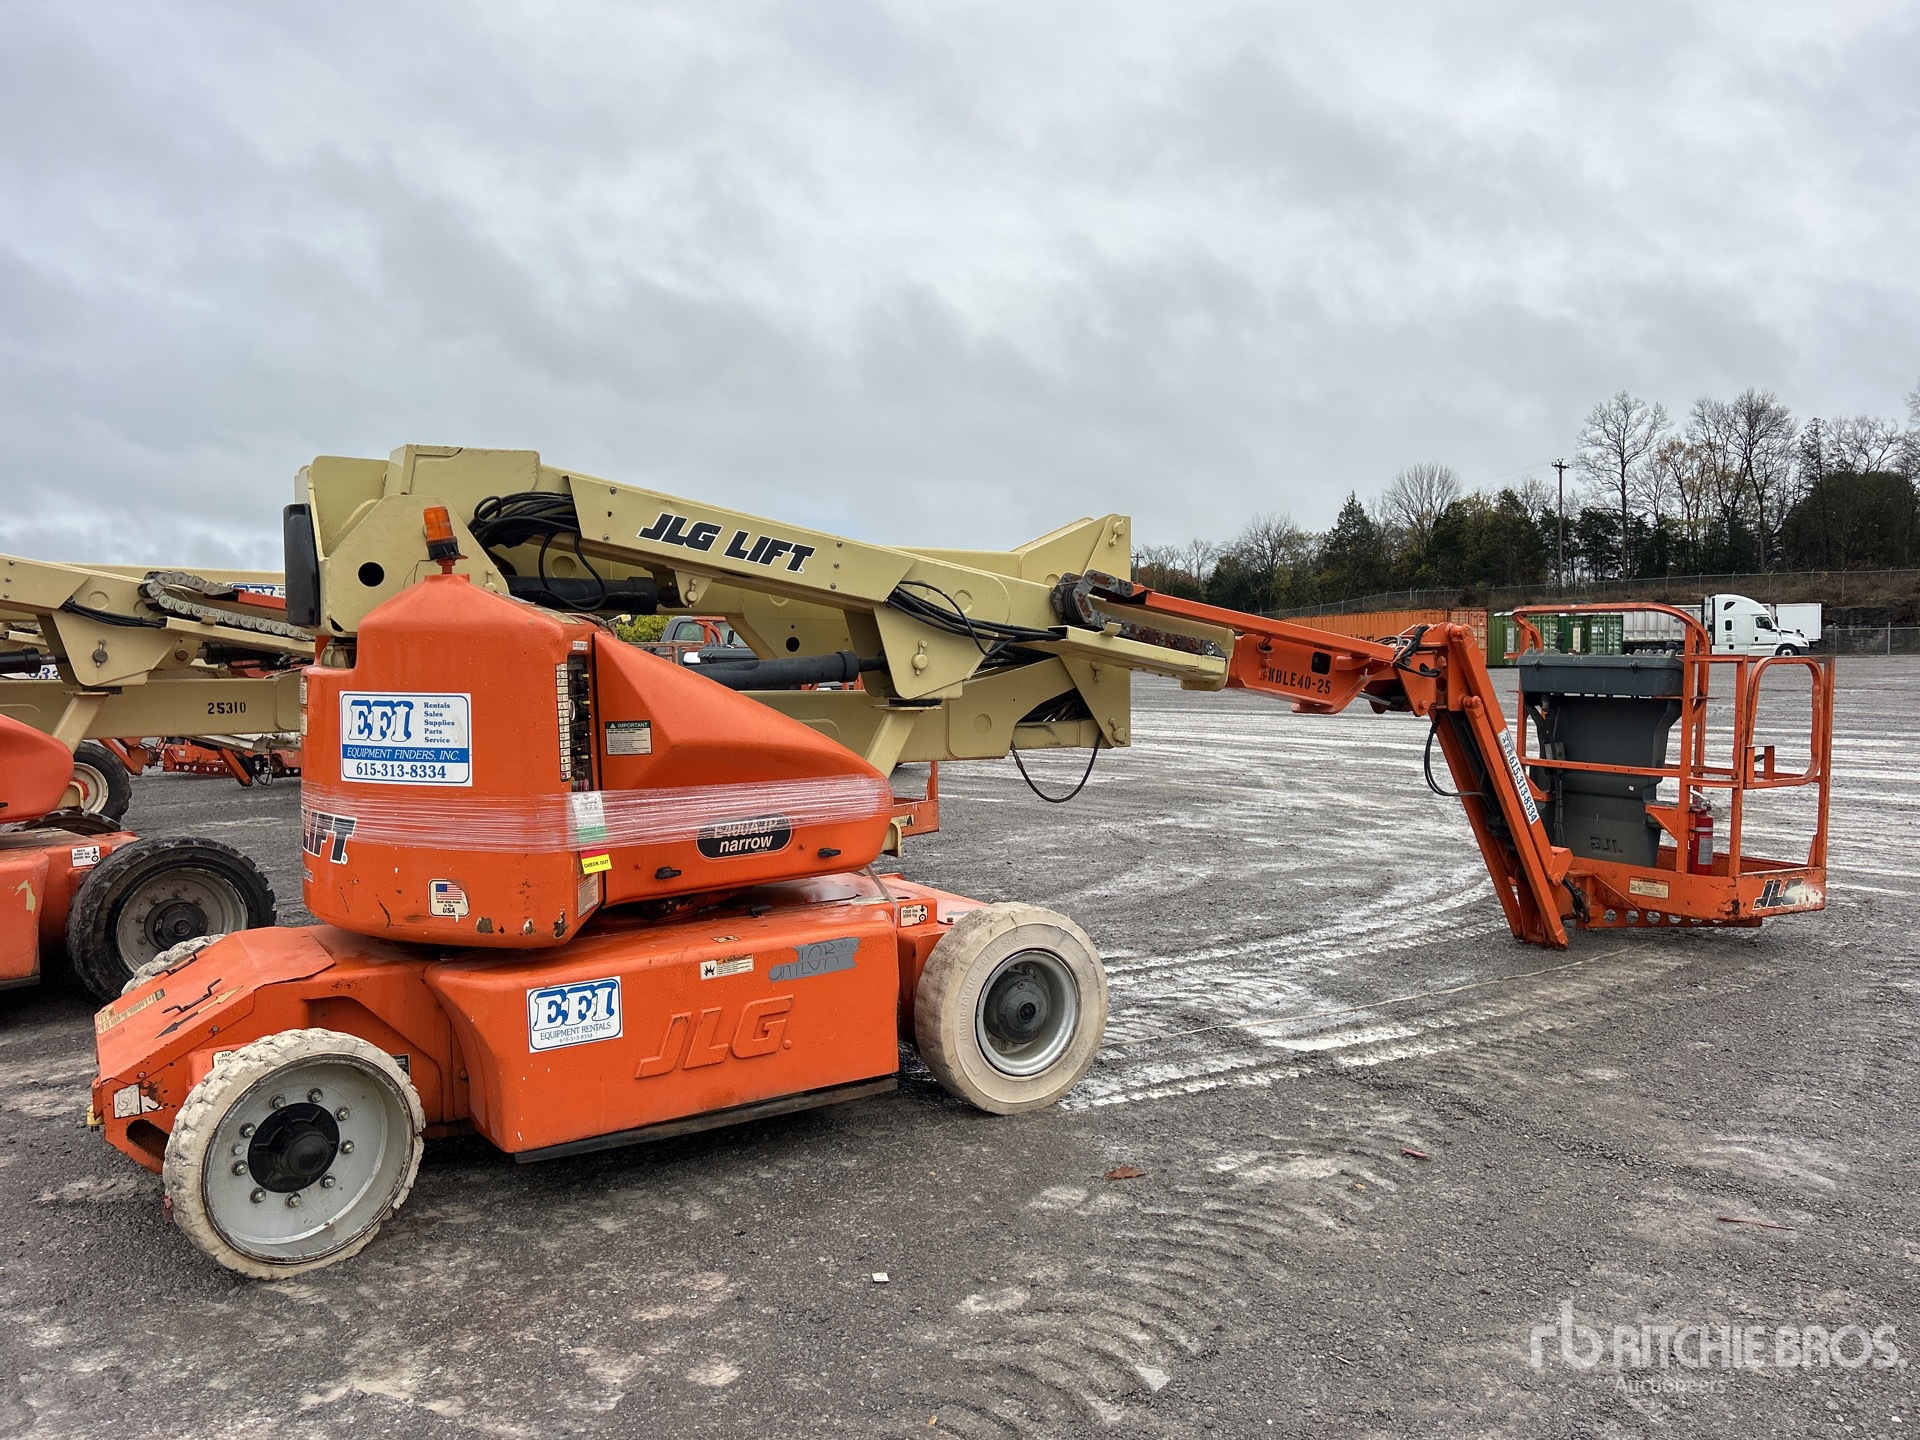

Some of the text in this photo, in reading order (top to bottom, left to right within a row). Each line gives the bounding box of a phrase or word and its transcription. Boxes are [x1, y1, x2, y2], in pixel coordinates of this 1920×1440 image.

[637, 512, 817, 573] JLG LIFT
[207, 701, 247, 715] 25310
[348, 699, 414, 742] EFI
[423, 719, 456, 727] Supplies
[617, 721, 648, 729] IMPORTANT
[346, 746, 461, 761] EQUIPMENT FINDERS, INC.
[355, 761, 447, 779] 615-313-8334
[1508, 755, 1538, 823] 615-313-8334
[718, 835, 774, 854] narrow
[600, 859, 609, 867] OUT
[532, 981, 617, 1031] EFI
[540, 1021, 612, 1041] EQUIPMENT RENTALS
[634, 994, 795, 1080] JLG
